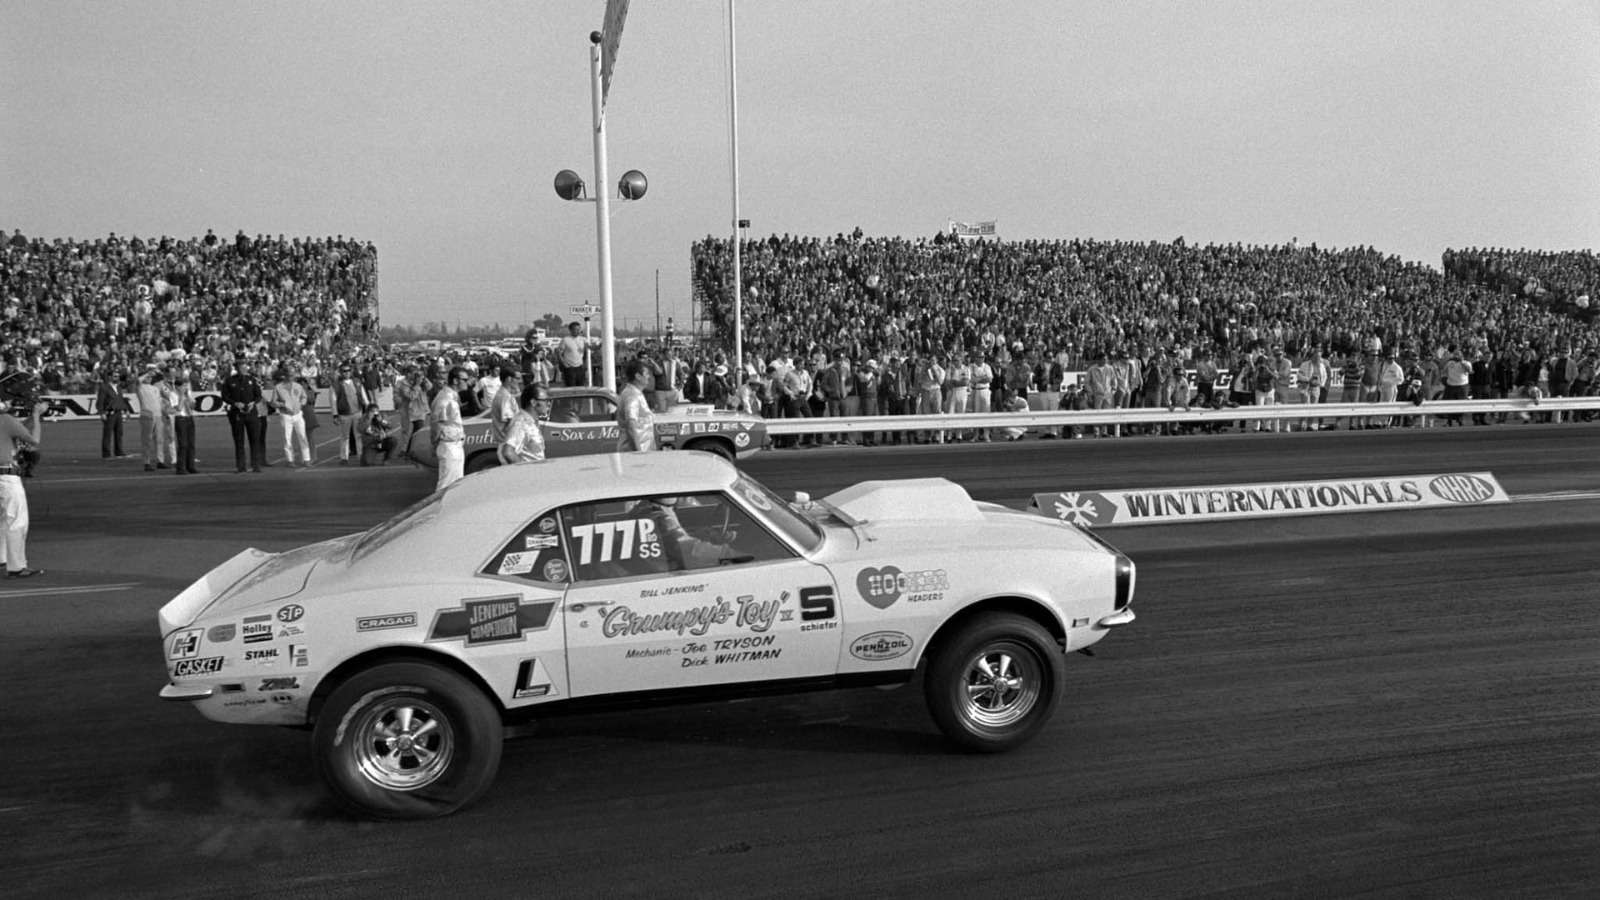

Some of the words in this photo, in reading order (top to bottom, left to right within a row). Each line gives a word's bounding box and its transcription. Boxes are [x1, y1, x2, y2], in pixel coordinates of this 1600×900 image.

[561, 428, 584, 441] Sox
[587, 430, 595, 440] &
[599, 426, 620, 439] Ma
[1434, 475, 1494, 502] NHRA
[1123, 481, 1422, 518] WINTERNATIONALS
[571, 519, 637, 566] 777
[639, 542, 661, 558] SS
[640, 590, 659, 598] BILL
[907, 593, 944, 602] HEADERS
[279, 606, 303, 621] STP
[470, 602, 516, 625] JENKINS
[243, 624, 272, 634] Holley
[360, 616, 413, 628] CRAGAR
[800, 621, 838, 632] schiefer
[682, 642, 707, 654] Joe
[714, 635, 775, 651] TRYSON
[855, 640, 908, 653] PENNZOIL
[245, 648, 280, 660] STAHL
[681, 656, 709, 668] Dick
[715, 648, 781, 665] WHITMAN
[177, 657, 222, 675] GASKET
